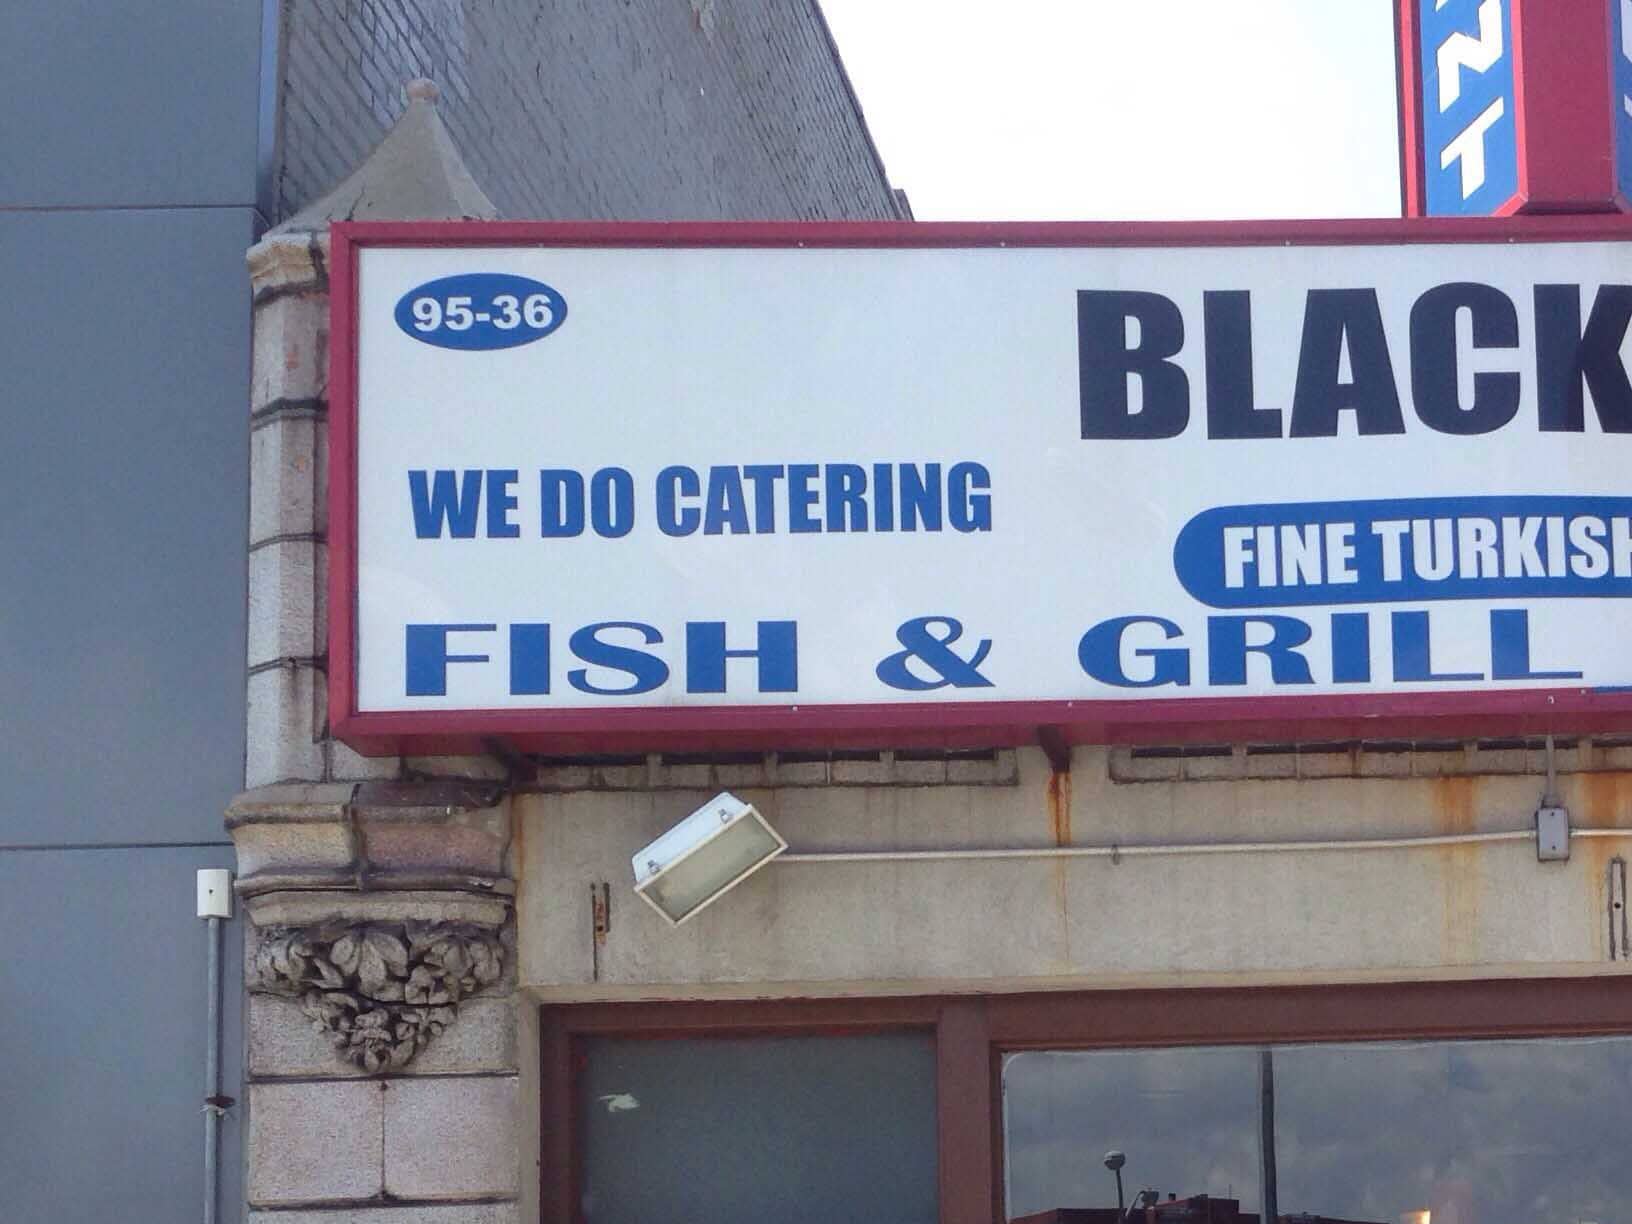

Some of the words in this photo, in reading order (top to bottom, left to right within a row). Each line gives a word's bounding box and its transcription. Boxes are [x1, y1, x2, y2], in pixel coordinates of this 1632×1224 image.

[411, 294, 554, 333] 95-36
[407, 468, 520, 540] WE
[540, 466, 635, 540] DO
[656, 461, 993, 537] CATERING
[1223, 520, 1358, 588] FINE
[404, 619, 799, 697] FISH
[875, 615, 996, 690] &
[1077, 608, 1584, 688] GRILL
